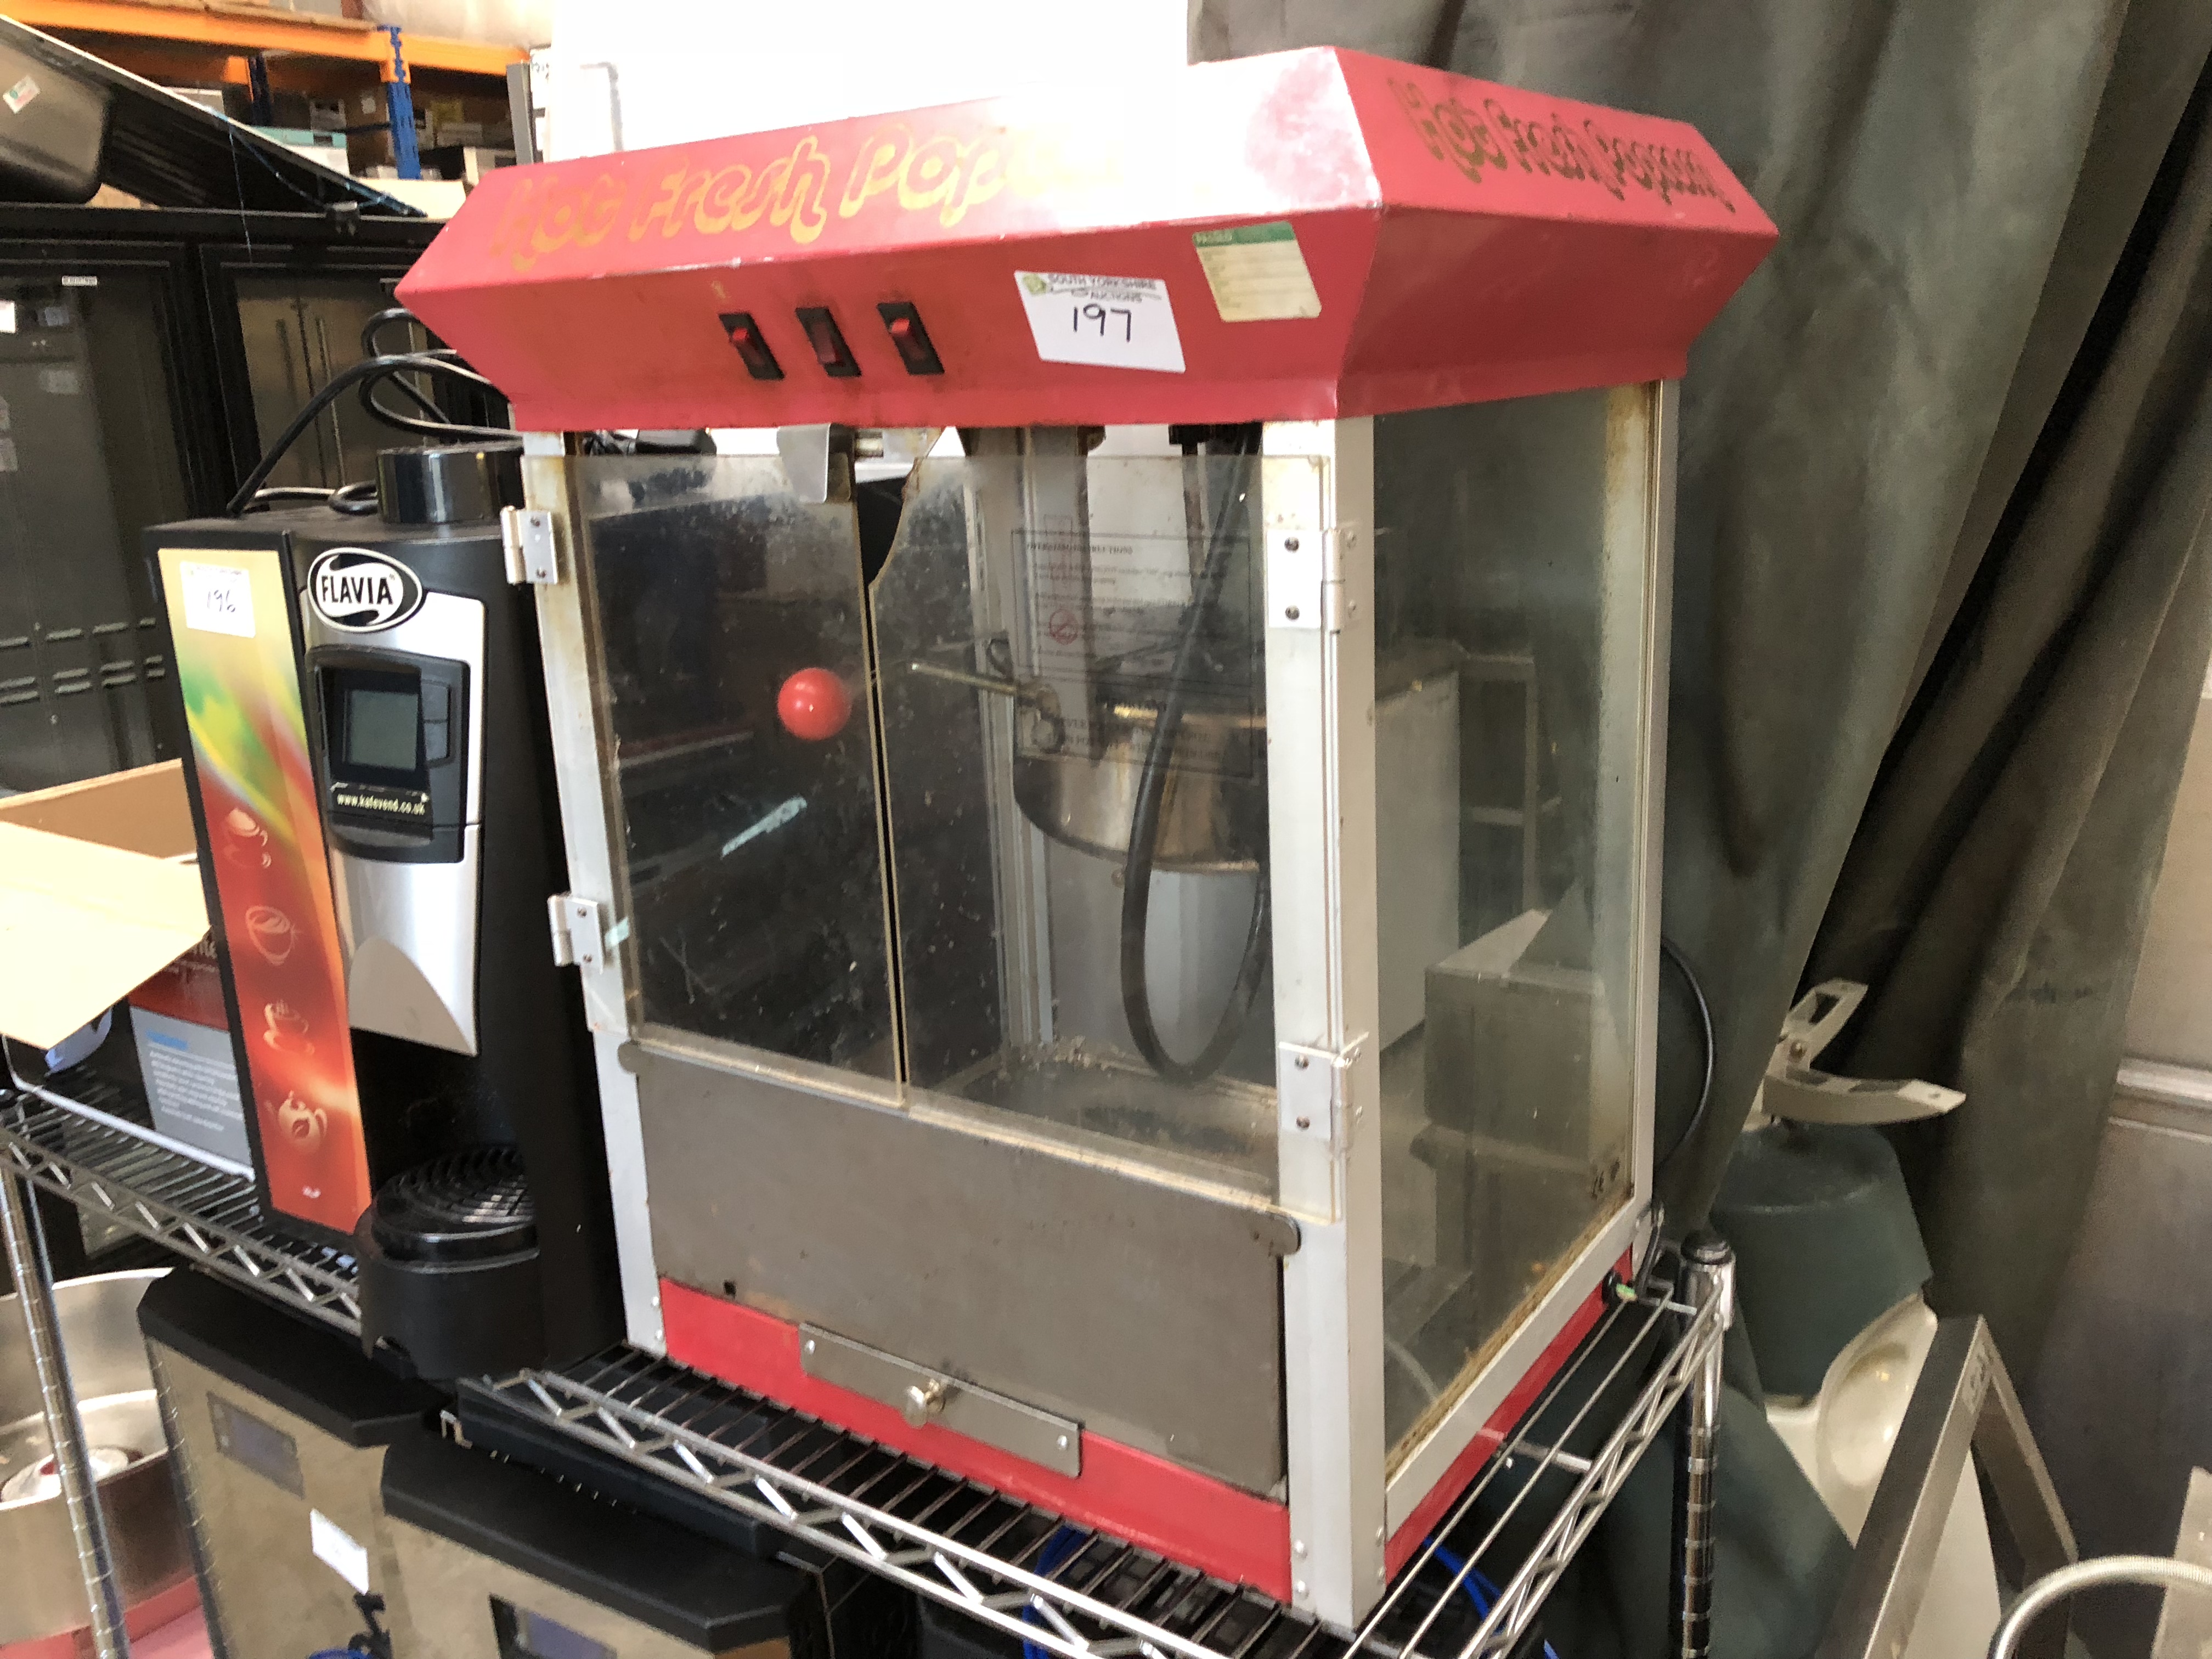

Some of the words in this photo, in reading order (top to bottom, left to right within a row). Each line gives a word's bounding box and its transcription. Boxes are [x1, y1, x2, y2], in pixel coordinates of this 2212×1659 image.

[625, 133, 830, 244] Fresh
[1073, 303, 1132, 343] 197
[206, 589, 236, 613] 196
[321, 574, 394, 605] FLAVIA
